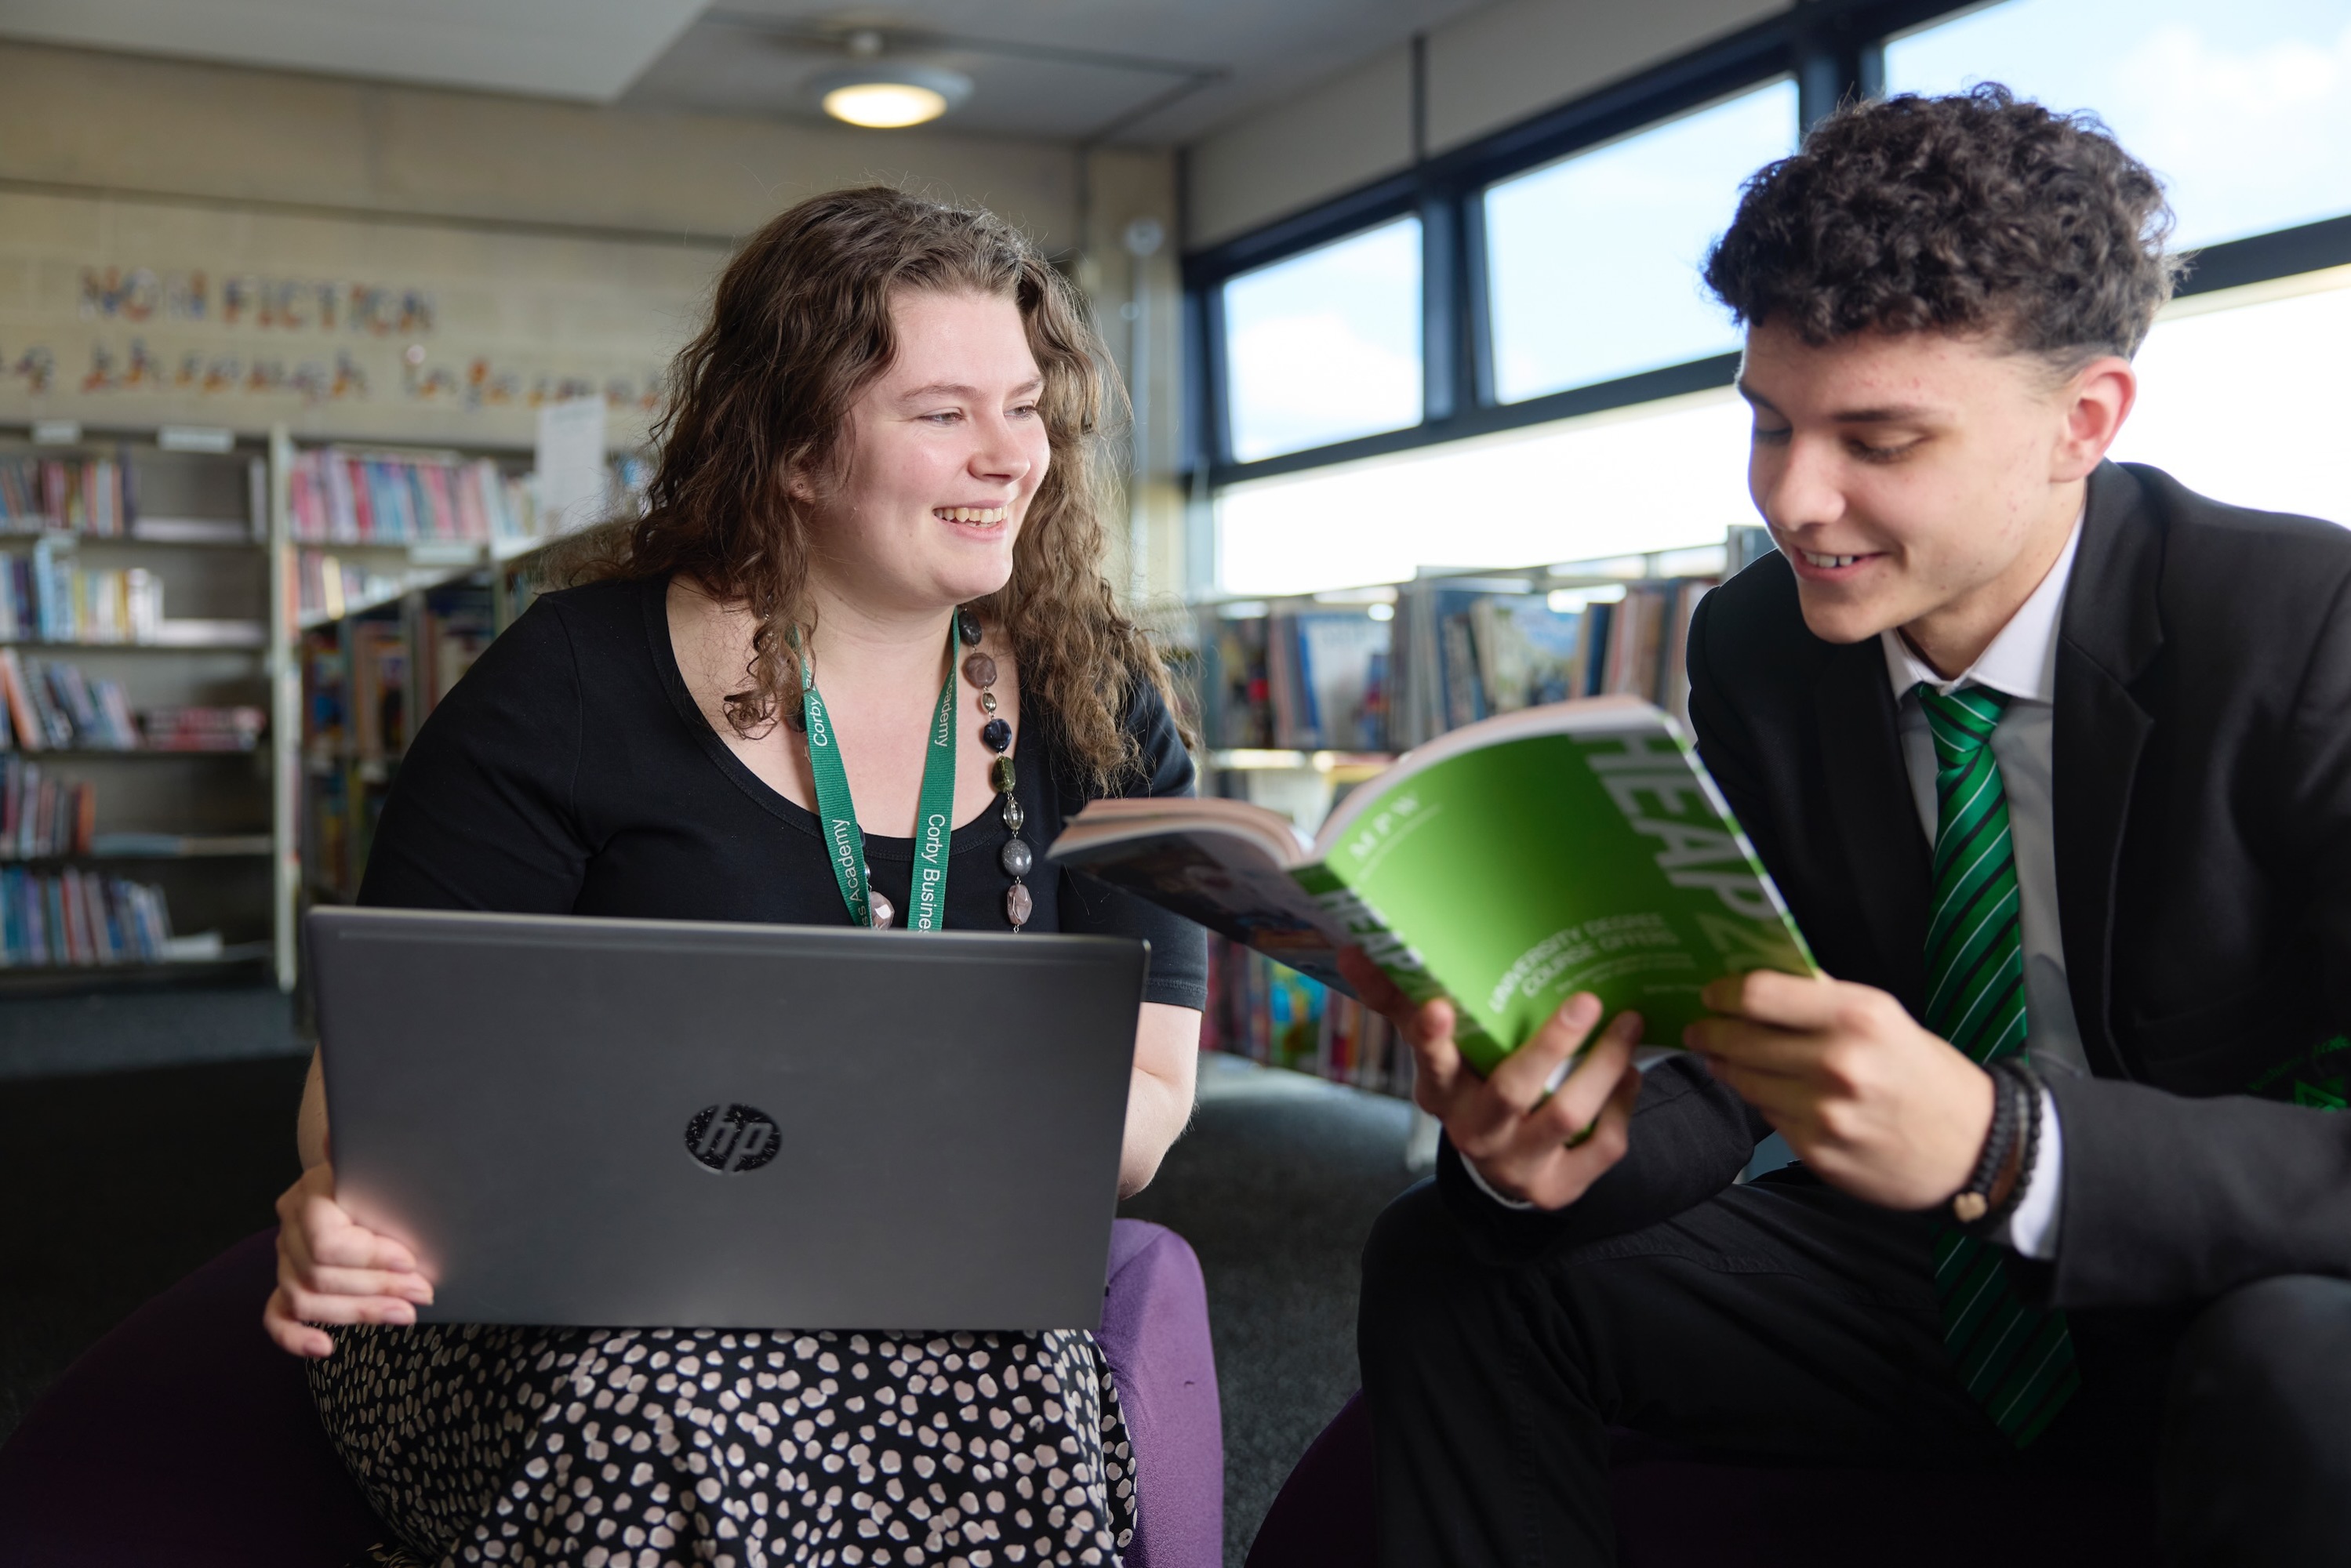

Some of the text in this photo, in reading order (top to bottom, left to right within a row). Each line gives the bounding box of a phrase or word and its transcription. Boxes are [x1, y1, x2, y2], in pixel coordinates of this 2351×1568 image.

[809, 695, 828, 747] Corby
[831, 818, 863, 902] Academy
[921, 814, 946, 864] Corby
[696, 1104, 774, 1173] hp
